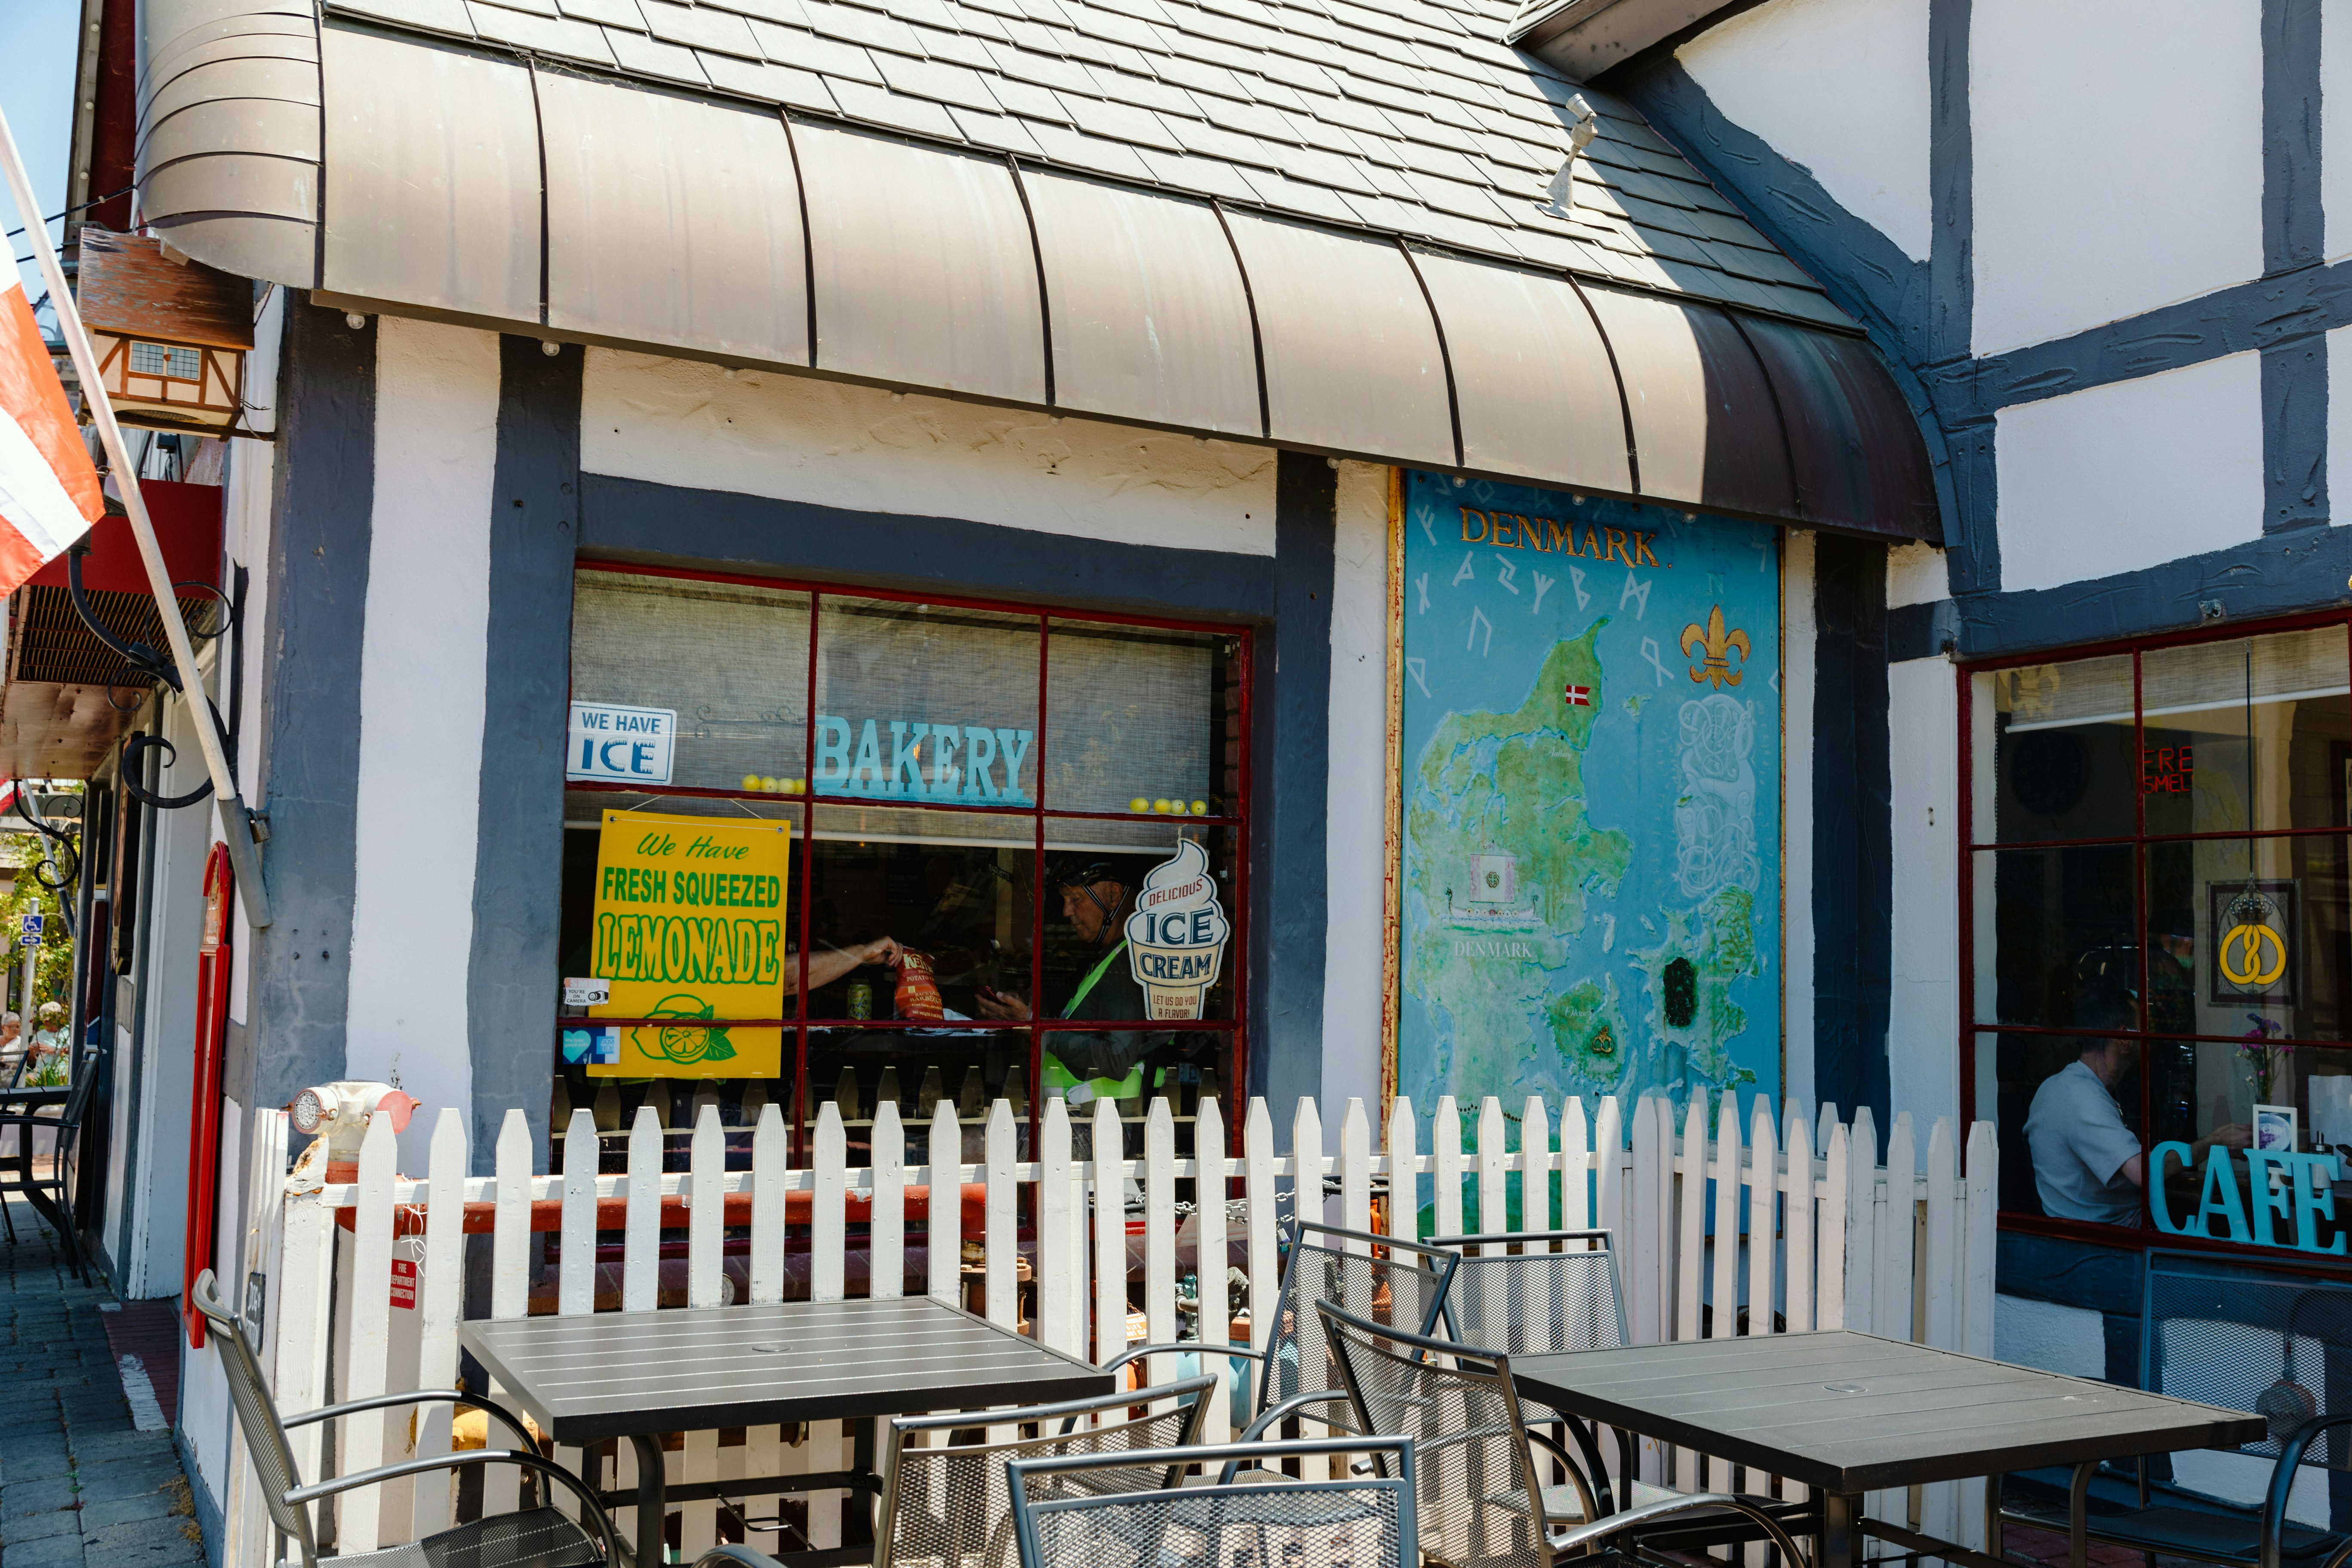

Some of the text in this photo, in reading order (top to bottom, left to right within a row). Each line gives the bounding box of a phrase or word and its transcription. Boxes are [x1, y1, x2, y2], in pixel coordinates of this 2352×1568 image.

[581, 712, 661, 734] WE HAVE
[582, 734, 656, 774] ICE
[814, 716, 1033, 798] BAKERY
[637, 832, 750, 860] We Have
[603, 866, 780, 908] FRESH SQUEEZED
[1148, 878, 1203, 906] DELICIOUS
[1146, 906, 1215, 945] ICE
[596, 912, 780, 985] LEMONADE
[1454, 940, 1533, 958] DENMARK
[1140, 952, 1213, 980] CREAM
[570, 979, 604, 988] SMILE
[1153, 994, 1197, 1006] LET US DO YOU
[1158, 1008, 1190, 1019] A FLAVOR!
[2149, 1141, 2347, 1255] CAFE
[391, 1275, 415, 1287] DEPARTMENT
[398, 1263, 407, 1274] FIRE
[390, 1287, 414, 1300] CONNECTION
